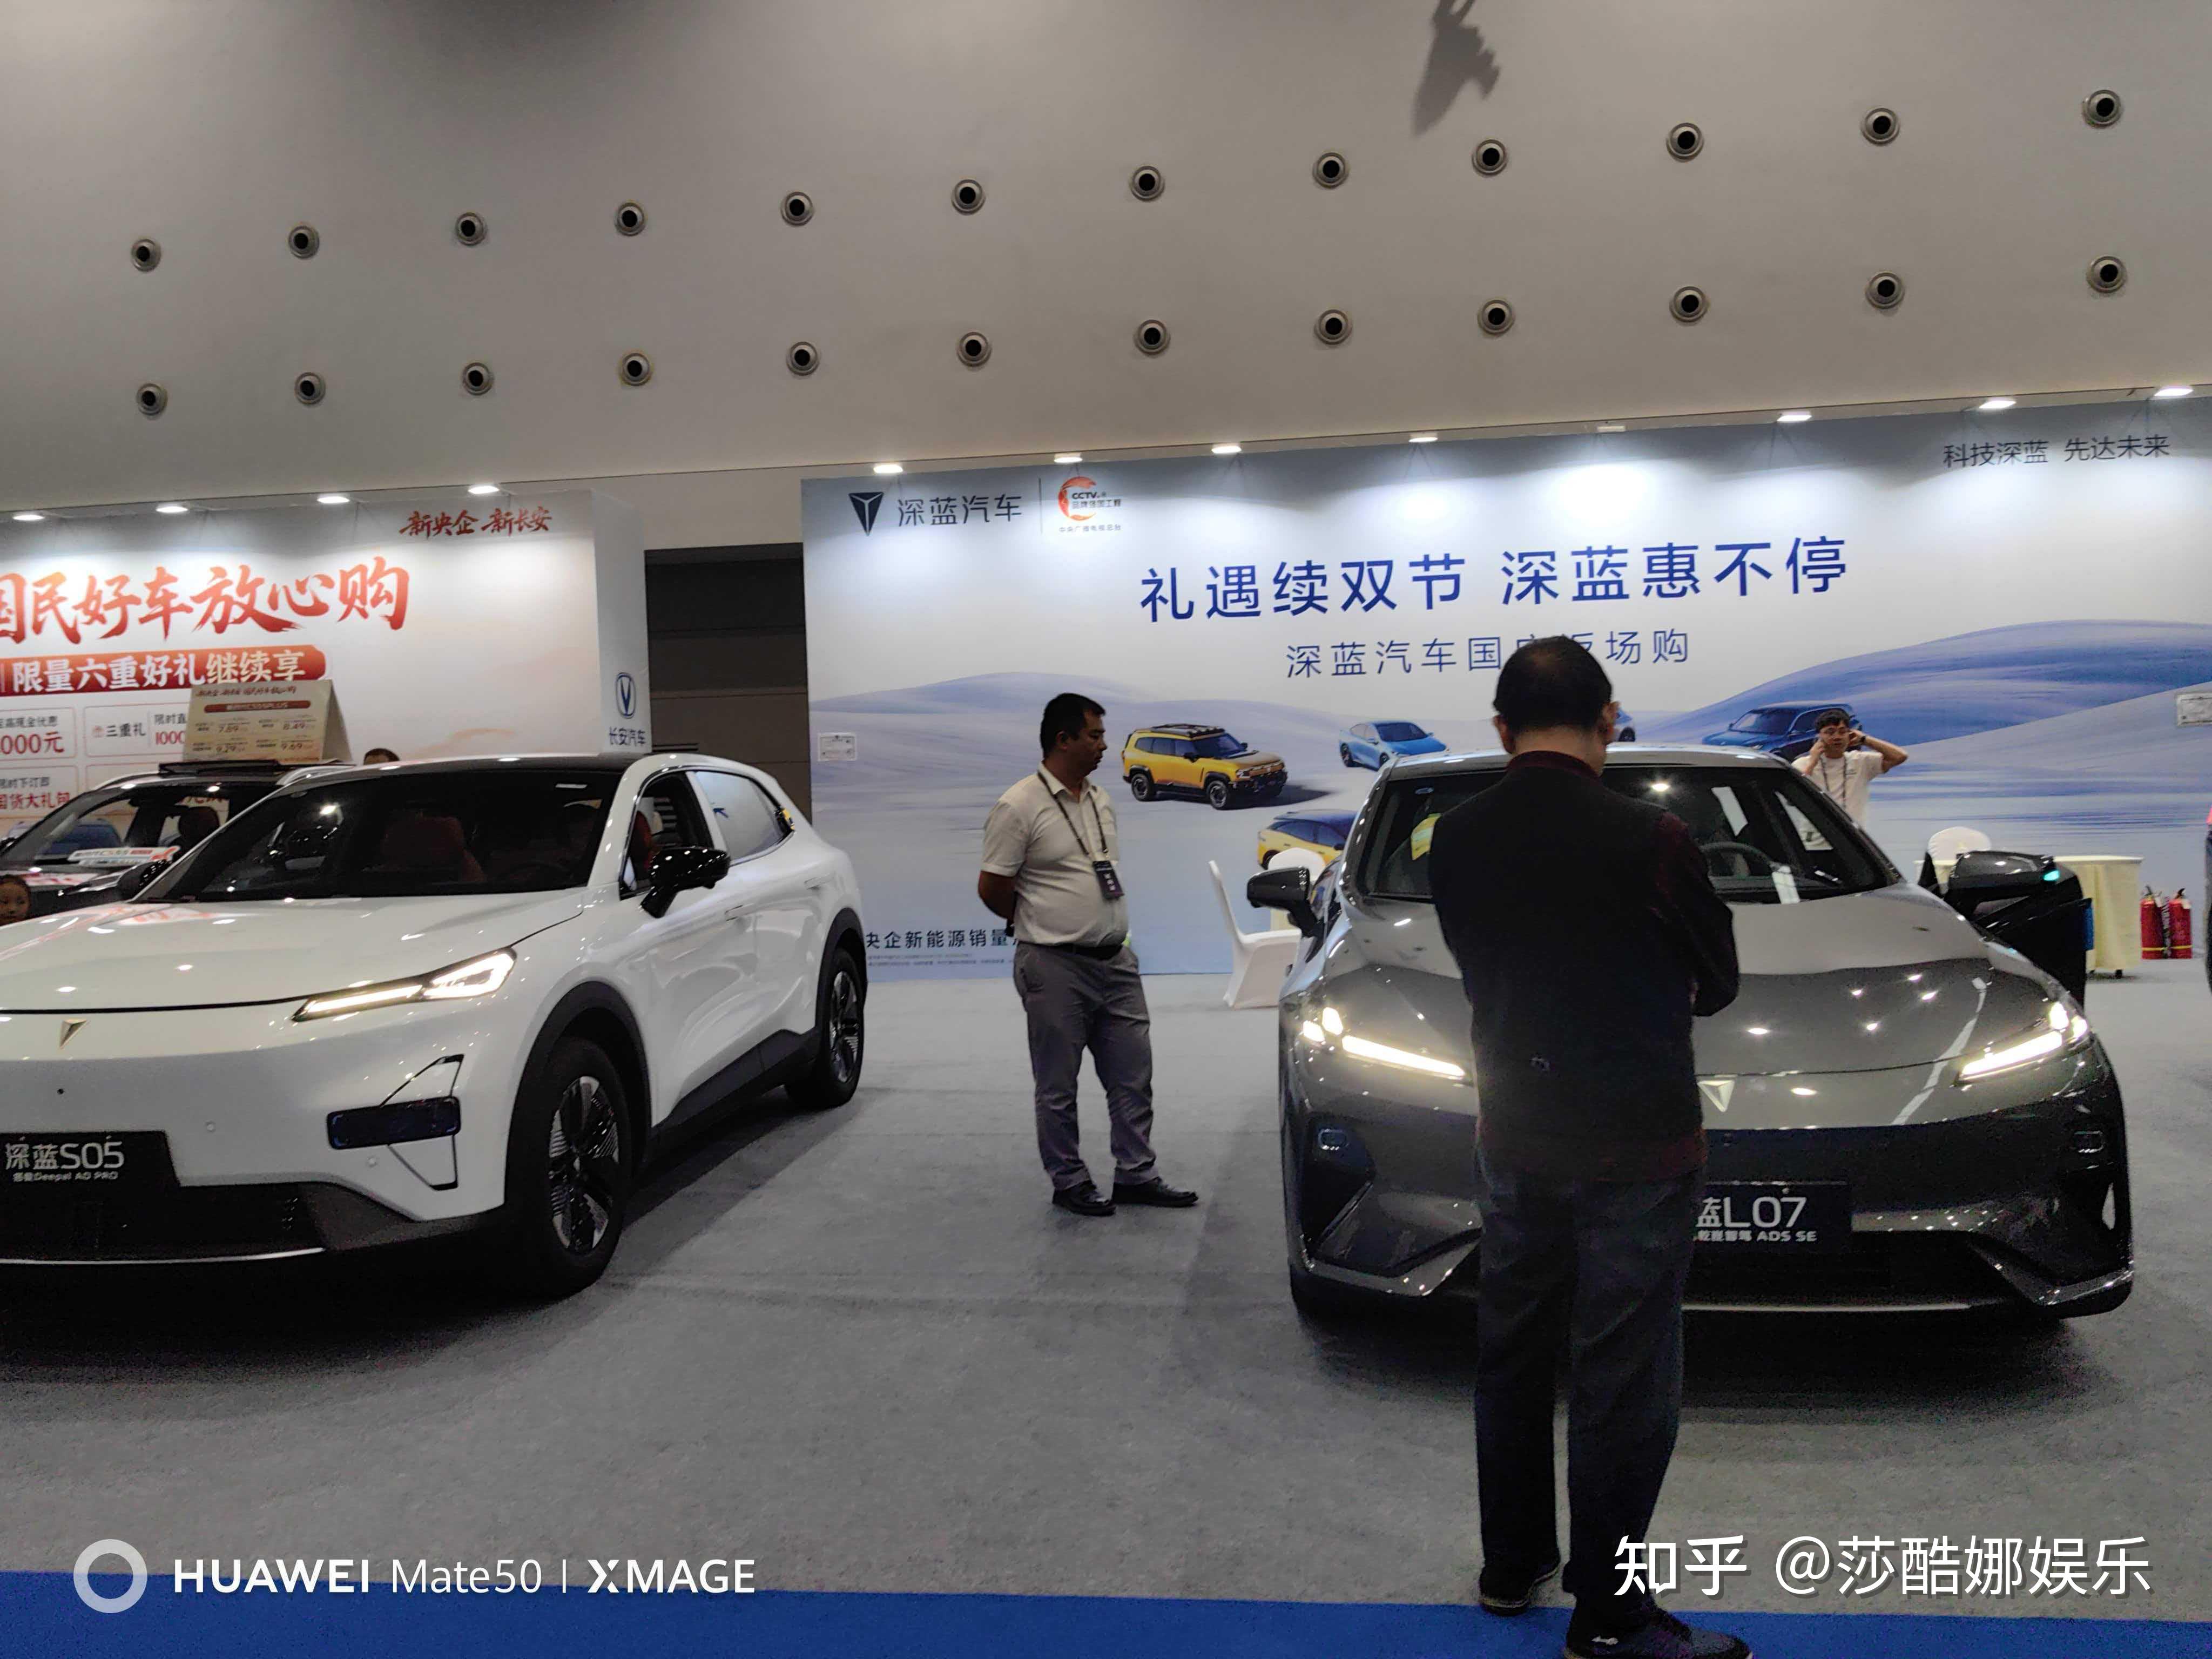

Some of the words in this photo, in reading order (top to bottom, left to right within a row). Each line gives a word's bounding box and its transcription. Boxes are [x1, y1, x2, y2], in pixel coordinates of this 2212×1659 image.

[1944, 440, 2049, 468] 科技深蓝
[2065, 434, 2170, 462] 先达未来
[399, 509, 480, 538] 新央企
[481, 506, 552, 536] 新长安
[898, 494, 1022, 527] 深蓝汽车
[1140, 552, 1465, 623] 礼遇续双节
[1501, 535, 1846, 606] 深蓝惠不停
[1286, 628, 1688, 679] 深蓝汽车国场购
[13, 649, 306, 693] 限量六重好礼继续享
[609, 727, 646, 746] 长安汽车
[866, 929, 1018, 949] 央企新能源销量
[5, 1141, 124, 1170] 深蓝S05
[1756, 1231, 1791, 1242] ADS
[1796, 1231, 1817, 1242] SE
